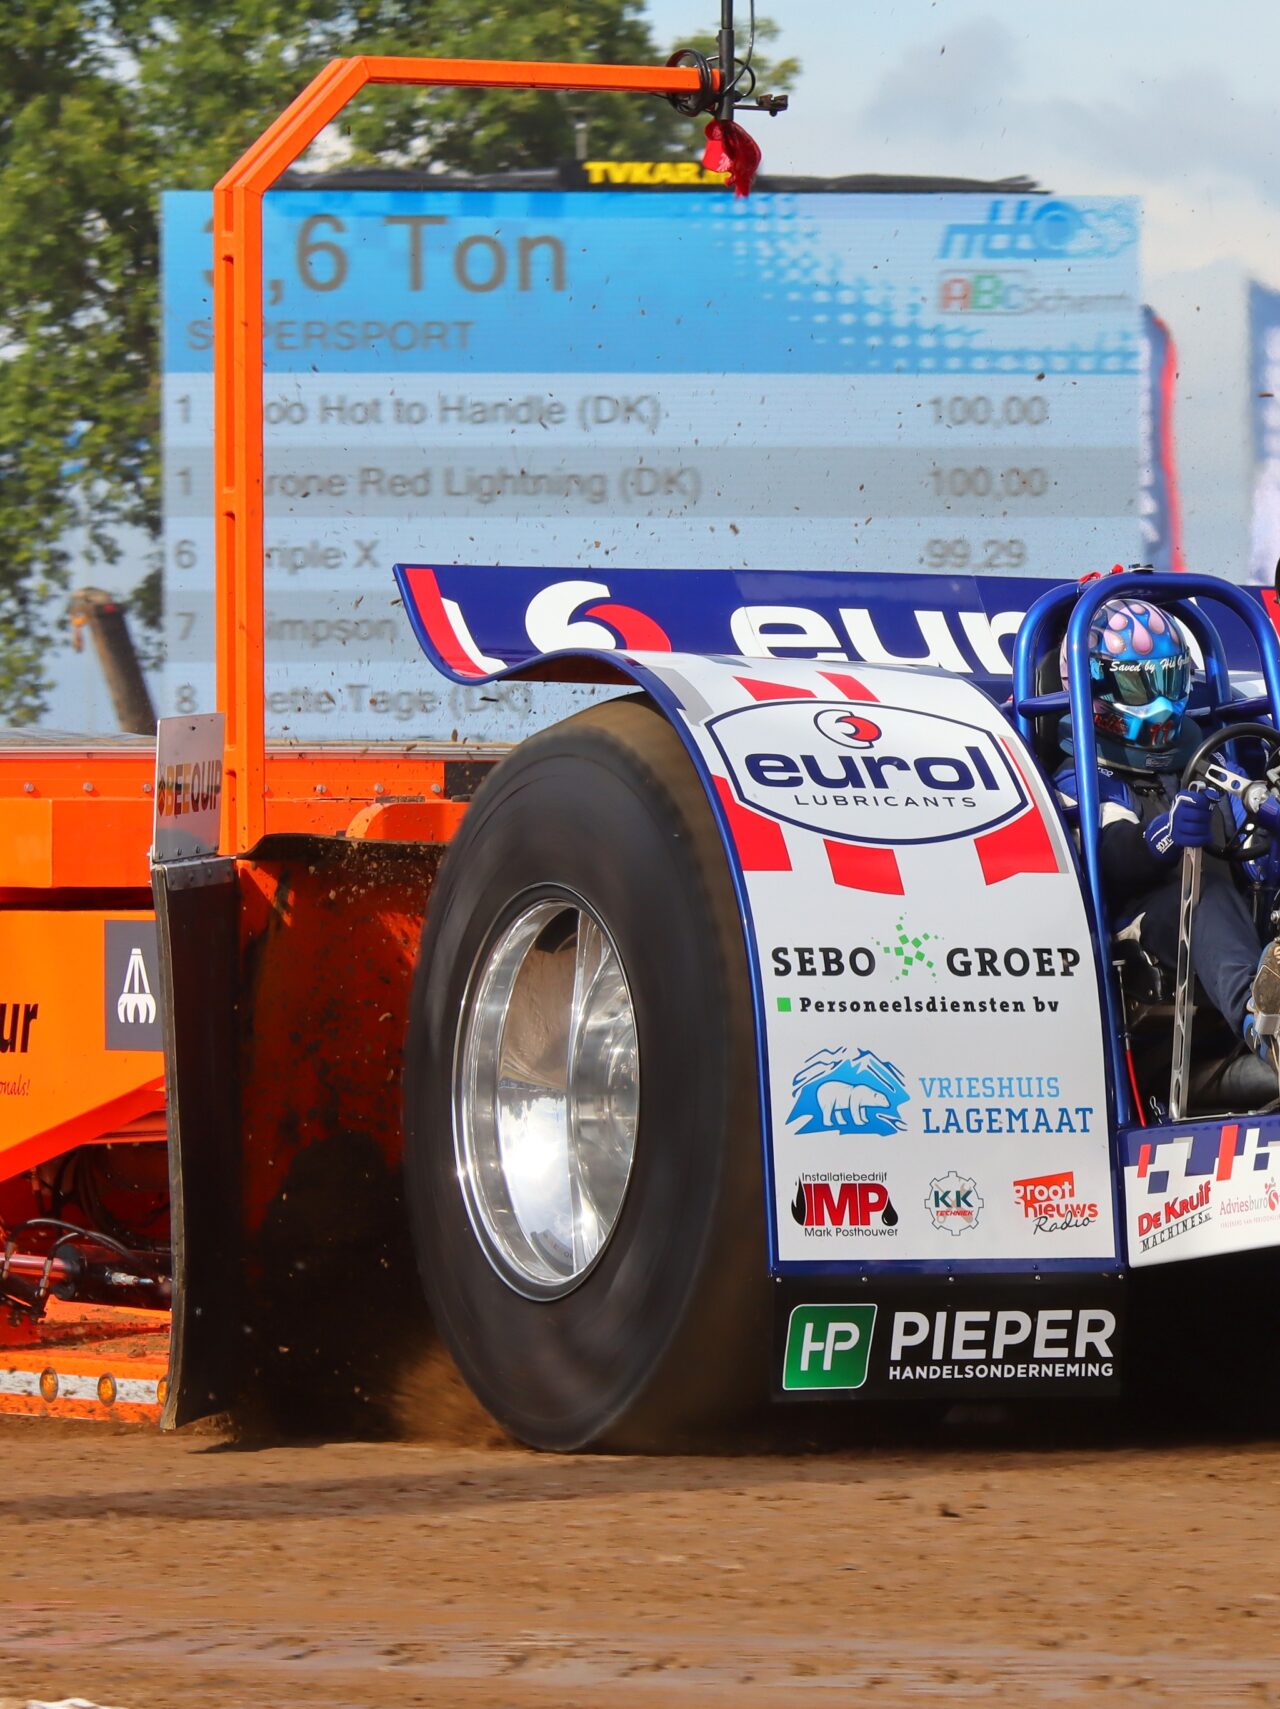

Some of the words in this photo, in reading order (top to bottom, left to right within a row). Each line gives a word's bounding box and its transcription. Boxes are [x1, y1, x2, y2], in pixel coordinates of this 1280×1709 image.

[203, 213, 348, 305] ,6
[384, 214, 567, 292] Ton
[187, 319, 475, 351] SERSPORT
[176, 394, 191, 424] 1
[264, 400, 307, 425] oo
[319, 394, 382, 424] Hot
[393, 396, 428, 424] to
[438, 393, 567, 424] Handle
[176, 466, 191, 496] 1
[264, 472, 348, 497] rone
[359, 467, 431, 497] Red
[444, 466, 608, 504] Lightning
[174, 538, 198, 570] 6
[264, 539, 343, 575] riple
[353, 538, 380, 568] X
[174, 611, 197, 641] 7
[264, 611, 398, 646] impson
[730, 606, 1030, 675] eur
[1109, 661, 1142, 672] Saved
[1144, 661, 1156, 674] by
[175, 685, 199, 714] 8
[265, 686, 337, 714] ette
[745, 745, 1001, 792] eurol
[794, 794, 977, 809] LUBRICANTS
[771, 946, 876, 977] SEBO
[946, 947, 1081, 977] GROEP
[799, 996, 1026, 1013] Personeelsdiensten
[1034, 997, 1060, 1013] bv
[918, 1077, 1061, 1099] VRIESHUIS
[922, 1107, 1094, 1134] LAGEMAAT
[801, 1171, 888, 1183] Installatiebedrijf
[804, 1183, 889, 1227] IMP
[1013, 1180, 1073, 1206] groot
[1024, 1203, 1099, 1218] nieuws
[1032, 1209, 1097, 1235] Radio
[804, 1226, 833, 1238] Mark
[835, 1226, 899, 1238] Posthouwer
[800, 1322, 860, 1372] HP
[890, 1308, 1117, 1361] PIEPER
[888, 1362, 1115, 1381] HANDELSONDERNEMING
